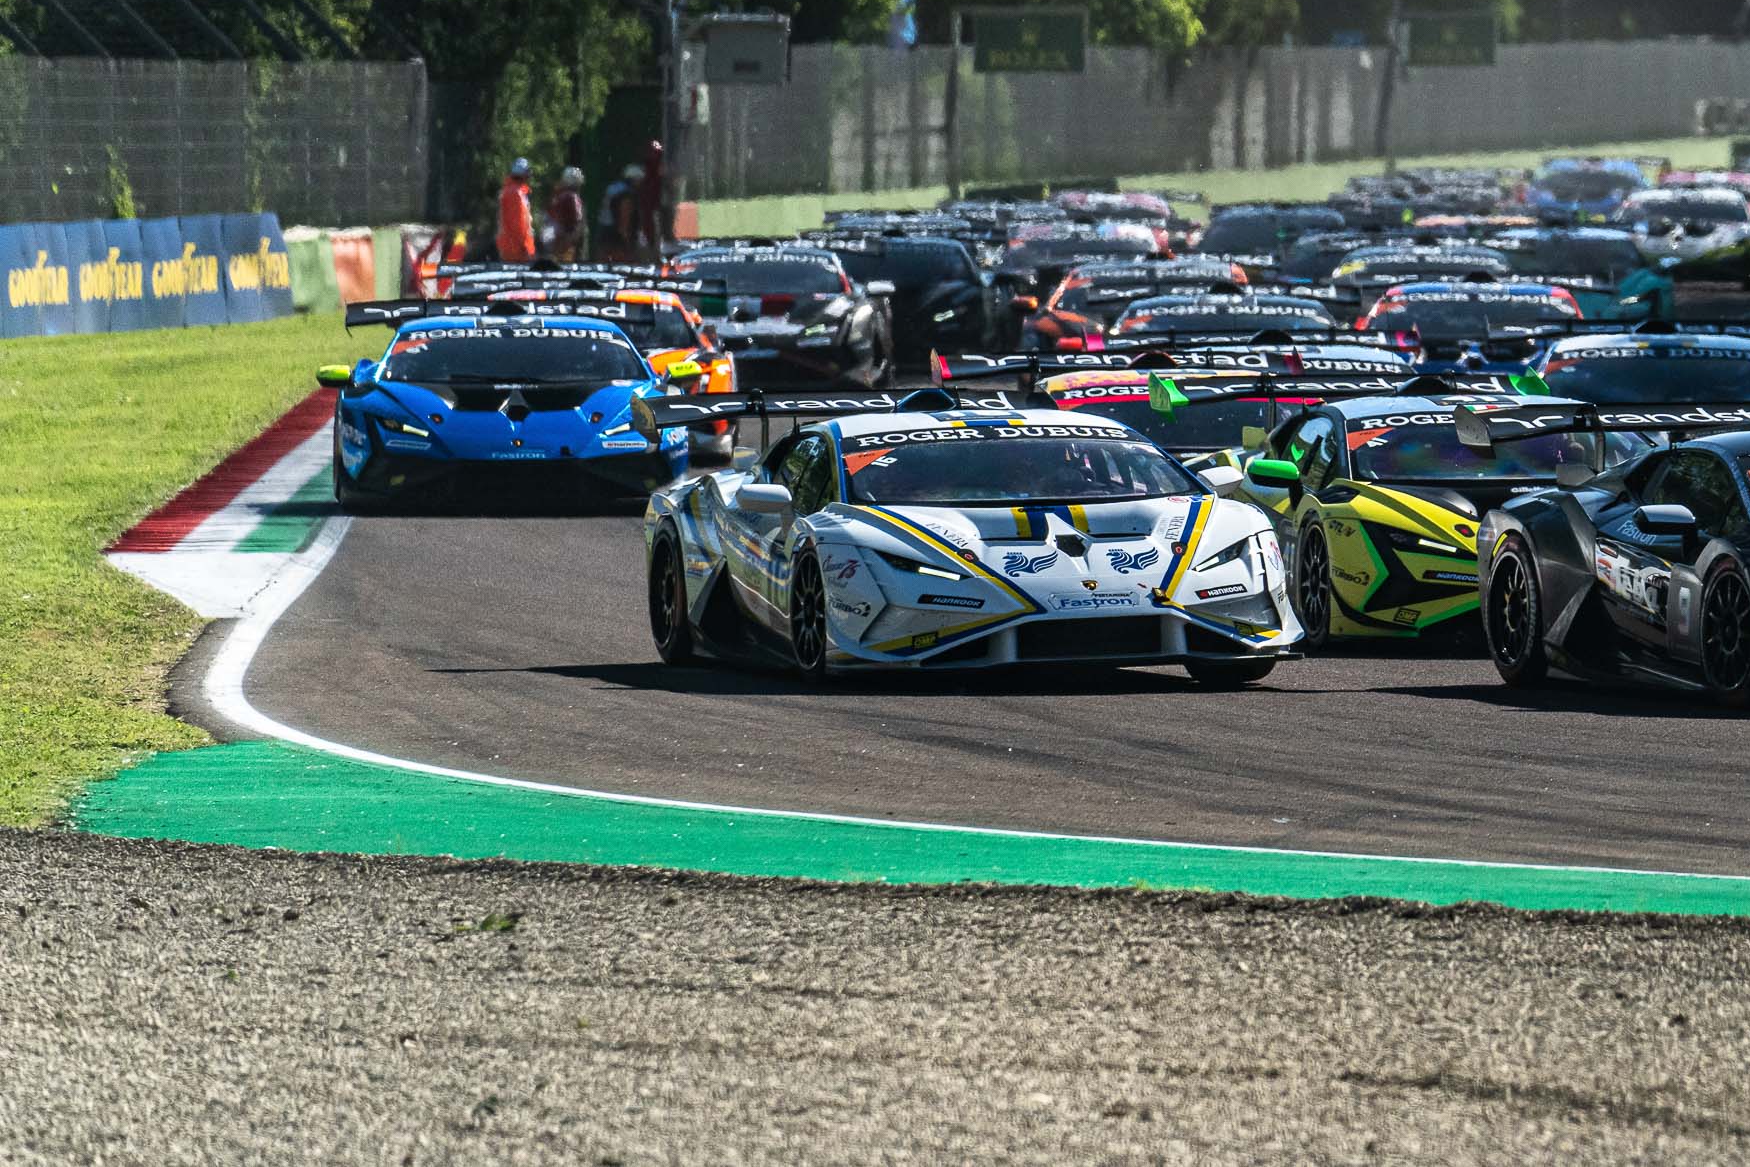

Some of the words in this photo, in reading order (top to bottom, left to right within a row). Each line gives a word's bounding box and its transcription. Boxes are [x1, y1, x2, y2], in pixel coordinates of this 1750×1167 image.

[408, 328, 503, 339] ROGER
[512, 328, 614, 341] DUBUIS
[1056, 352, 1268, 368] ranstad
[1563, 349, 1654, 359] ROGER
[1063, 385, 1150, 400] ROGE
[1276, 376, 1506, 394] randad
[774, 391, 1014, 410] randad
[1360, 414, 1456, 430] ROGE
[857, 428, 984, 447] ROGER
[998, 425, 1129, 439] DUBUIS
[871, 455, 898, 468] 16
[1060, 596, 1133, 608] Fastron
